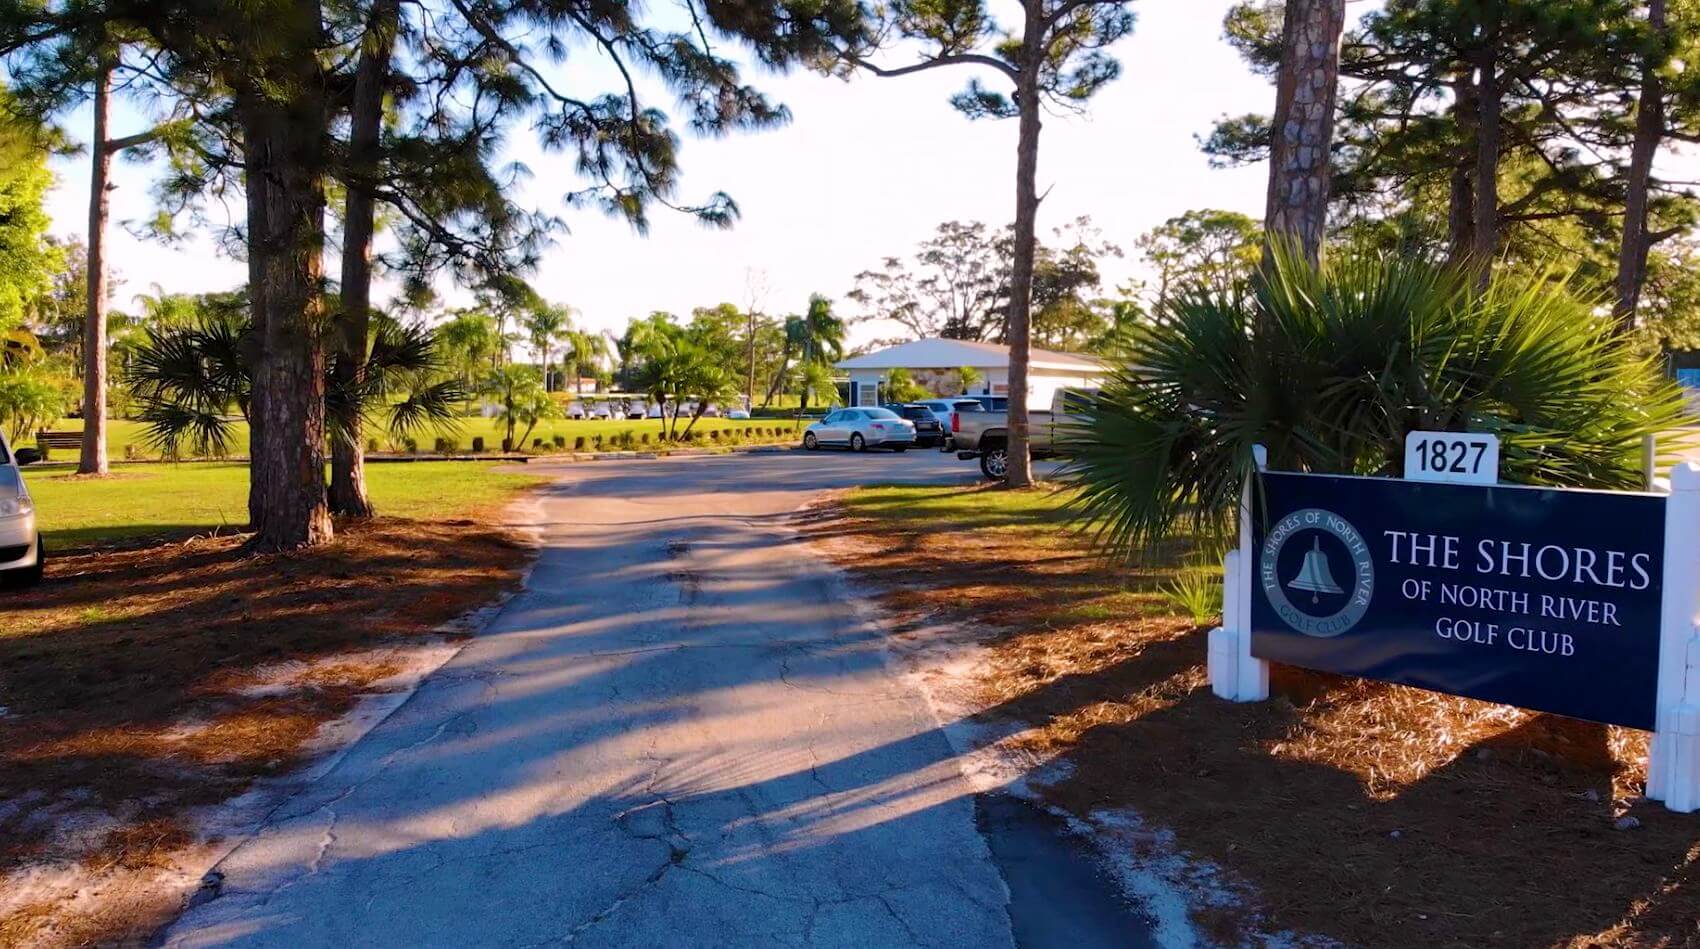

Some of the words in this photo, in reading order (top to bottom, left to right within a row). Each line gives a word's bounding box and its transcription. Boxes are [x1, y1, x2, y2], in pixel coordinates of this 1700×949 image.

[1416, 439, 1488, 474] 1827
[1265, 515, 1302, 557] SHORES
[1305, 511, 1321, 525] OF
[1326, 516, 1365, 556] NORTH
[1263, 561, 1276, 592] THE
[1383, 529, 1460, 570] THE
[1476, 538, 1651, 591] SHORES
[1354, 560, 1372, 608] RIVER
[1402, 578, 1432, 601] OF
[1440, 582, 1530, 615] NORTH
[1540, 594, 1622, 627] RIVER
[1280, 604, 1314, 632] GOLF
[1316, 613, 1351, 633] CLUB
[1435, 616, 1499, 646] GOLF
[1507, 626, 1575, 657] CLUB
